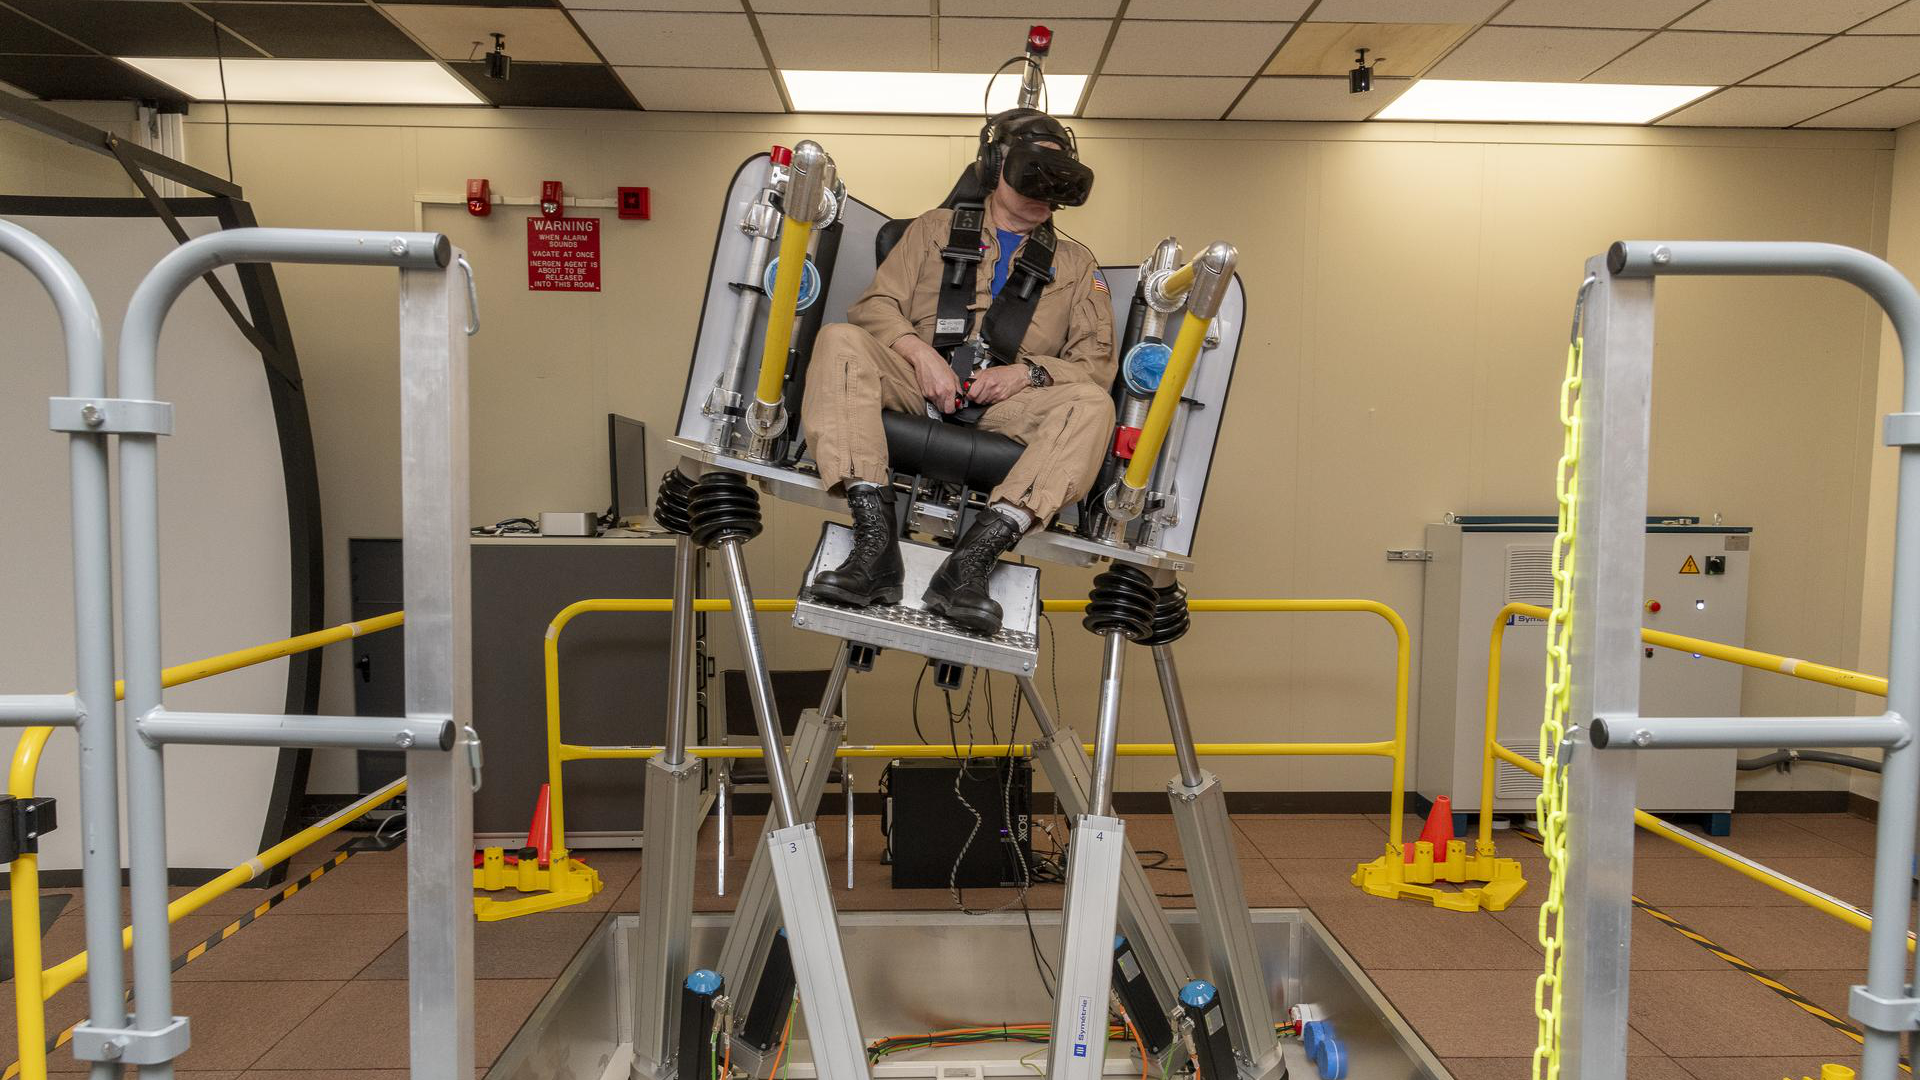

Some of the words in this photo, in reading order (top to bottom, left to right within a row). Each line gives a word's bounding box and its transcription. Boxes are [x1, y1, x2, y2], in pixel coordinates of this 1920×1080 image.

[533, 220, 593, 232] WARNING
[1018, 814, 1028, 842] BOXX
[1096, 831, 1104, 842] 4
[788, 842, 797, 853] 3
[1077, 999, 1088, 1041] Symétrie
